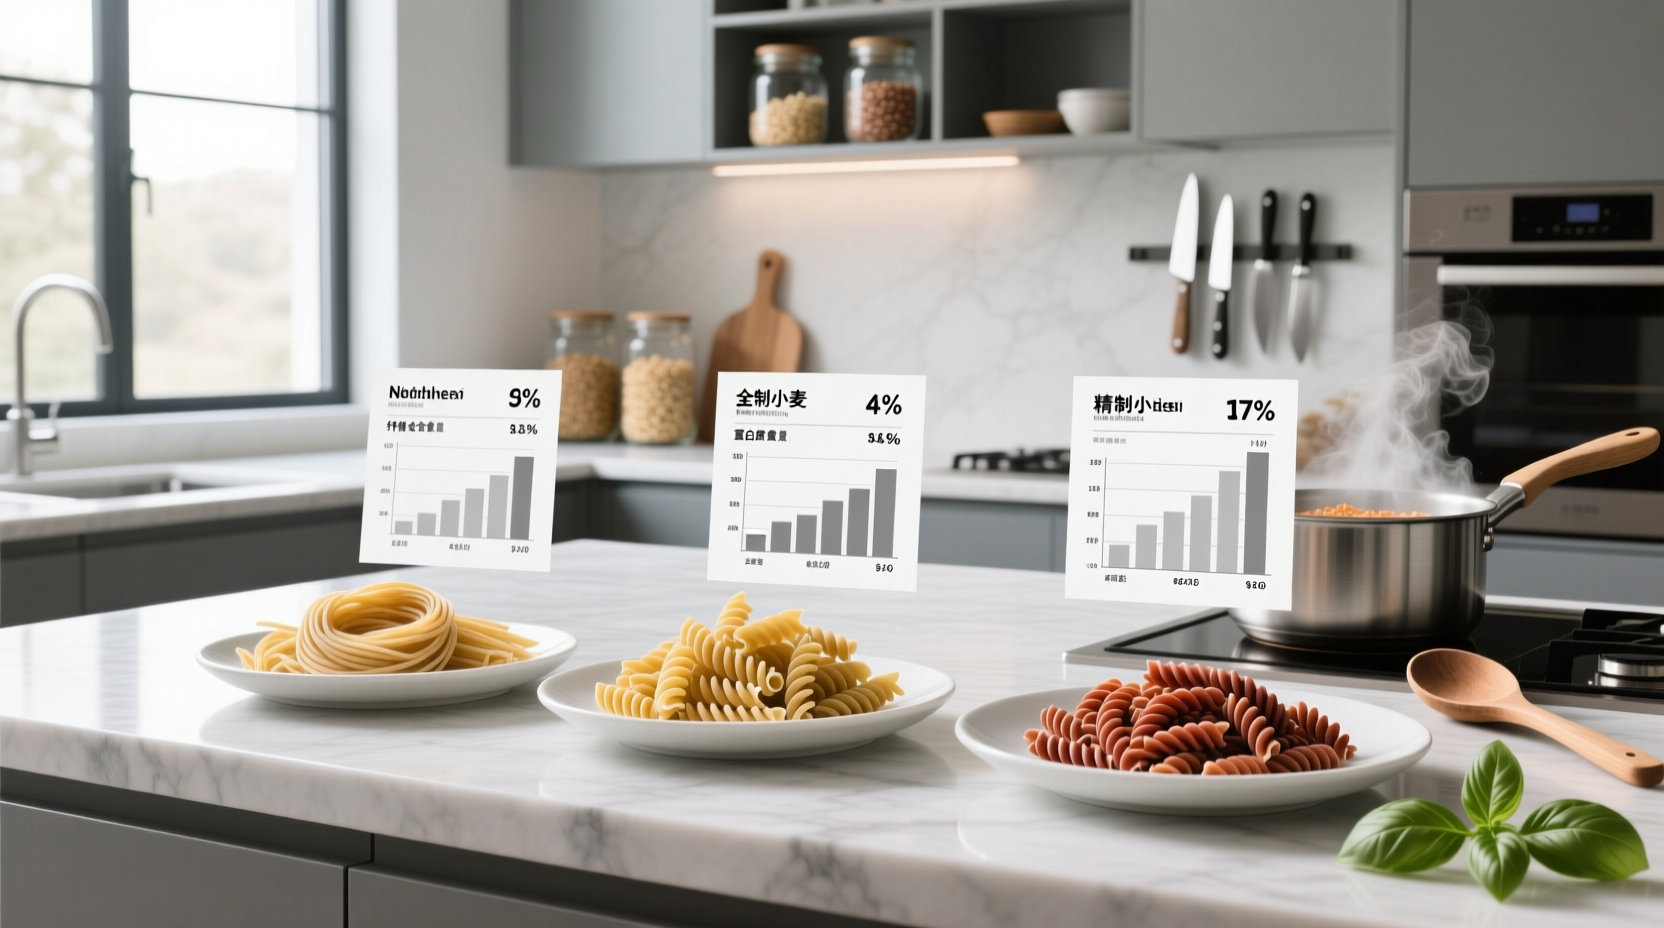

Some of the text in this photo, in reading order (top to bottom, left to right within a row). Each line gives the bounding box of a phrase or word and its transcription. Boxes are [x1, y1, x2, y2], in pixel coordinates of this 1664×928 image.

[735, 388, 808, 409] 全制小麦
[865, 393, 903, 416] 4%
[1226, 399, 1276, 422] 17%
